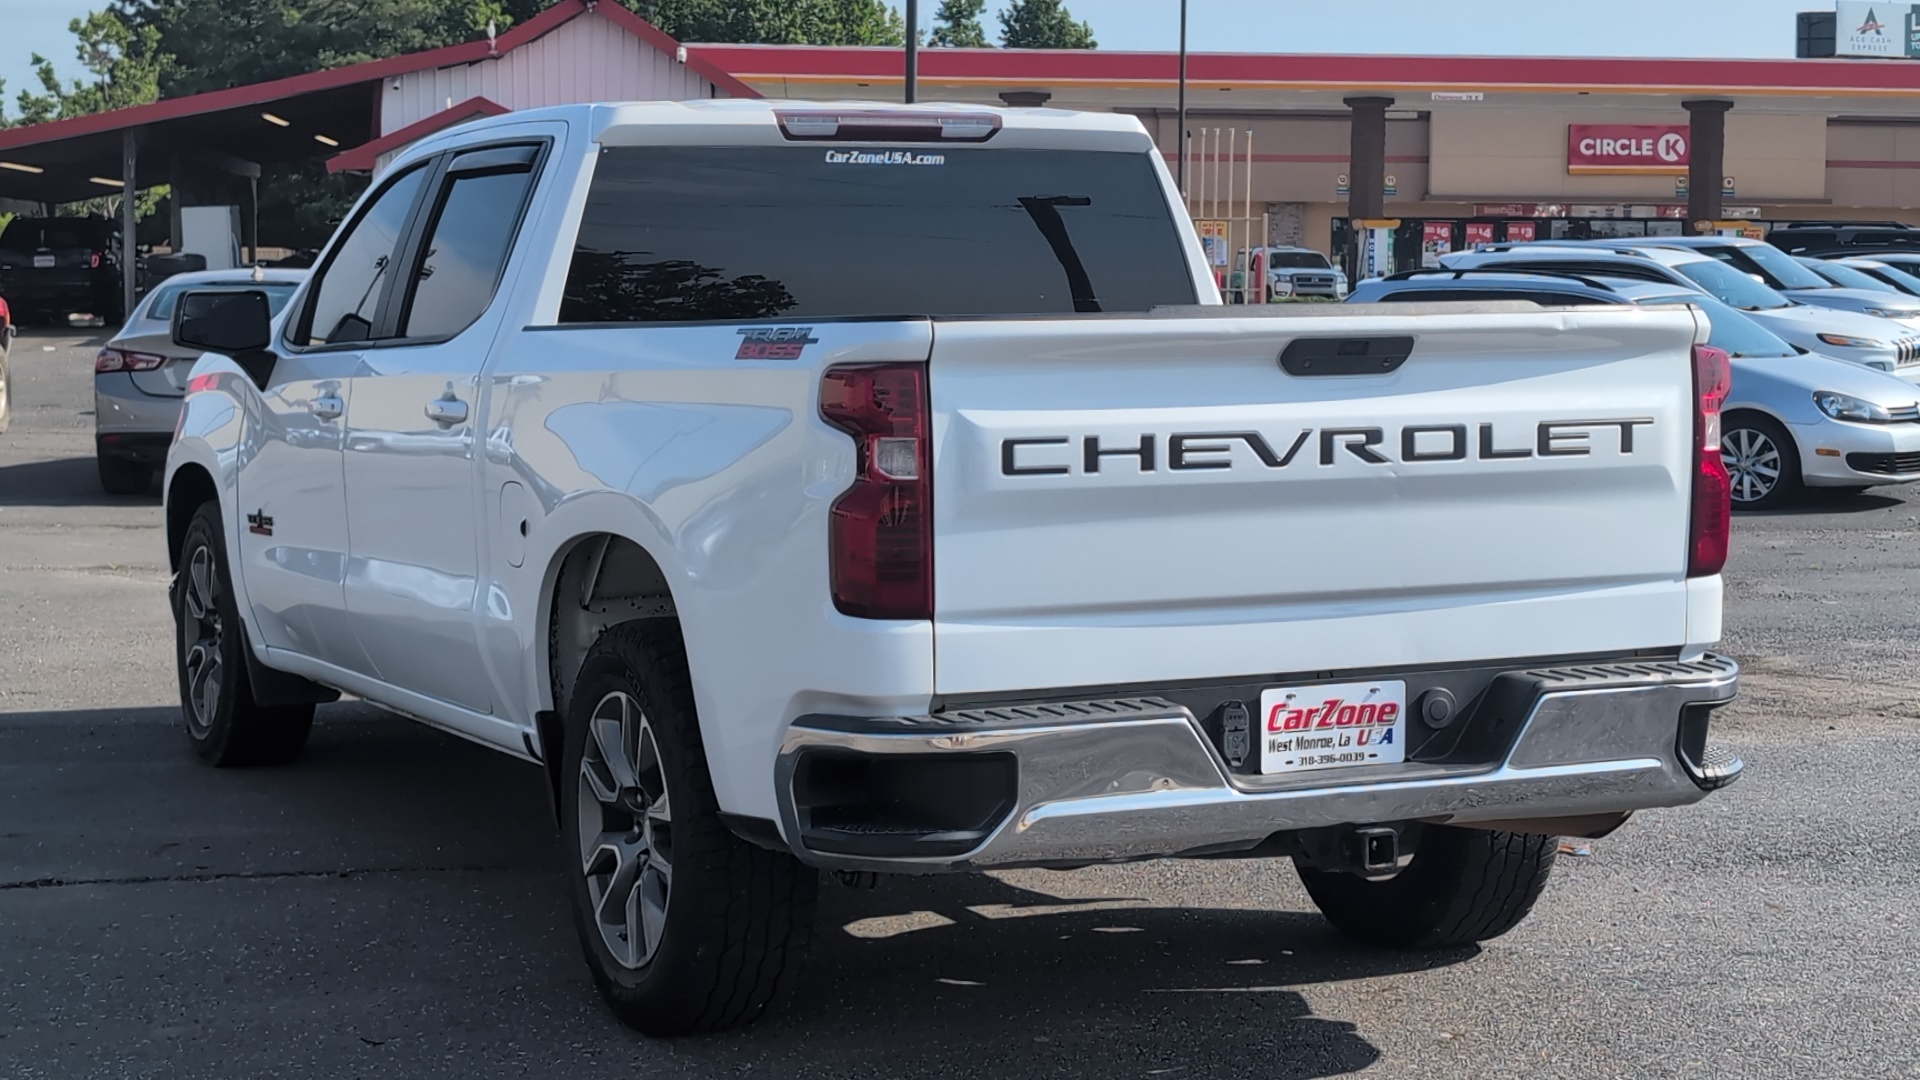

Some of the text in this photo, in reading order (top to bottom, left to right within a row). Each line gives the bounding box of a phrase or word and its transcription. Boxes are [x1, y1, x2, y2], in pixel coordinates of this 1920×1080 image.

[1851, 44, 1888, 52] EXPRESS
[1579, 138, 1653, 156] CIRCLE
[825, 150, 945, 165] CarZoneUSA.com
[735, 343, 805, 360] BOSS
[1001, 417, 1654, 476] CHEVROLET
[1267, 699, 1399, 733] CarZone
[1269, 732, 1351, 753] West Monroe, La
[1357, 728, 1393, 746] USA
[1299, 752, 1365, 766] 318-396-0039
